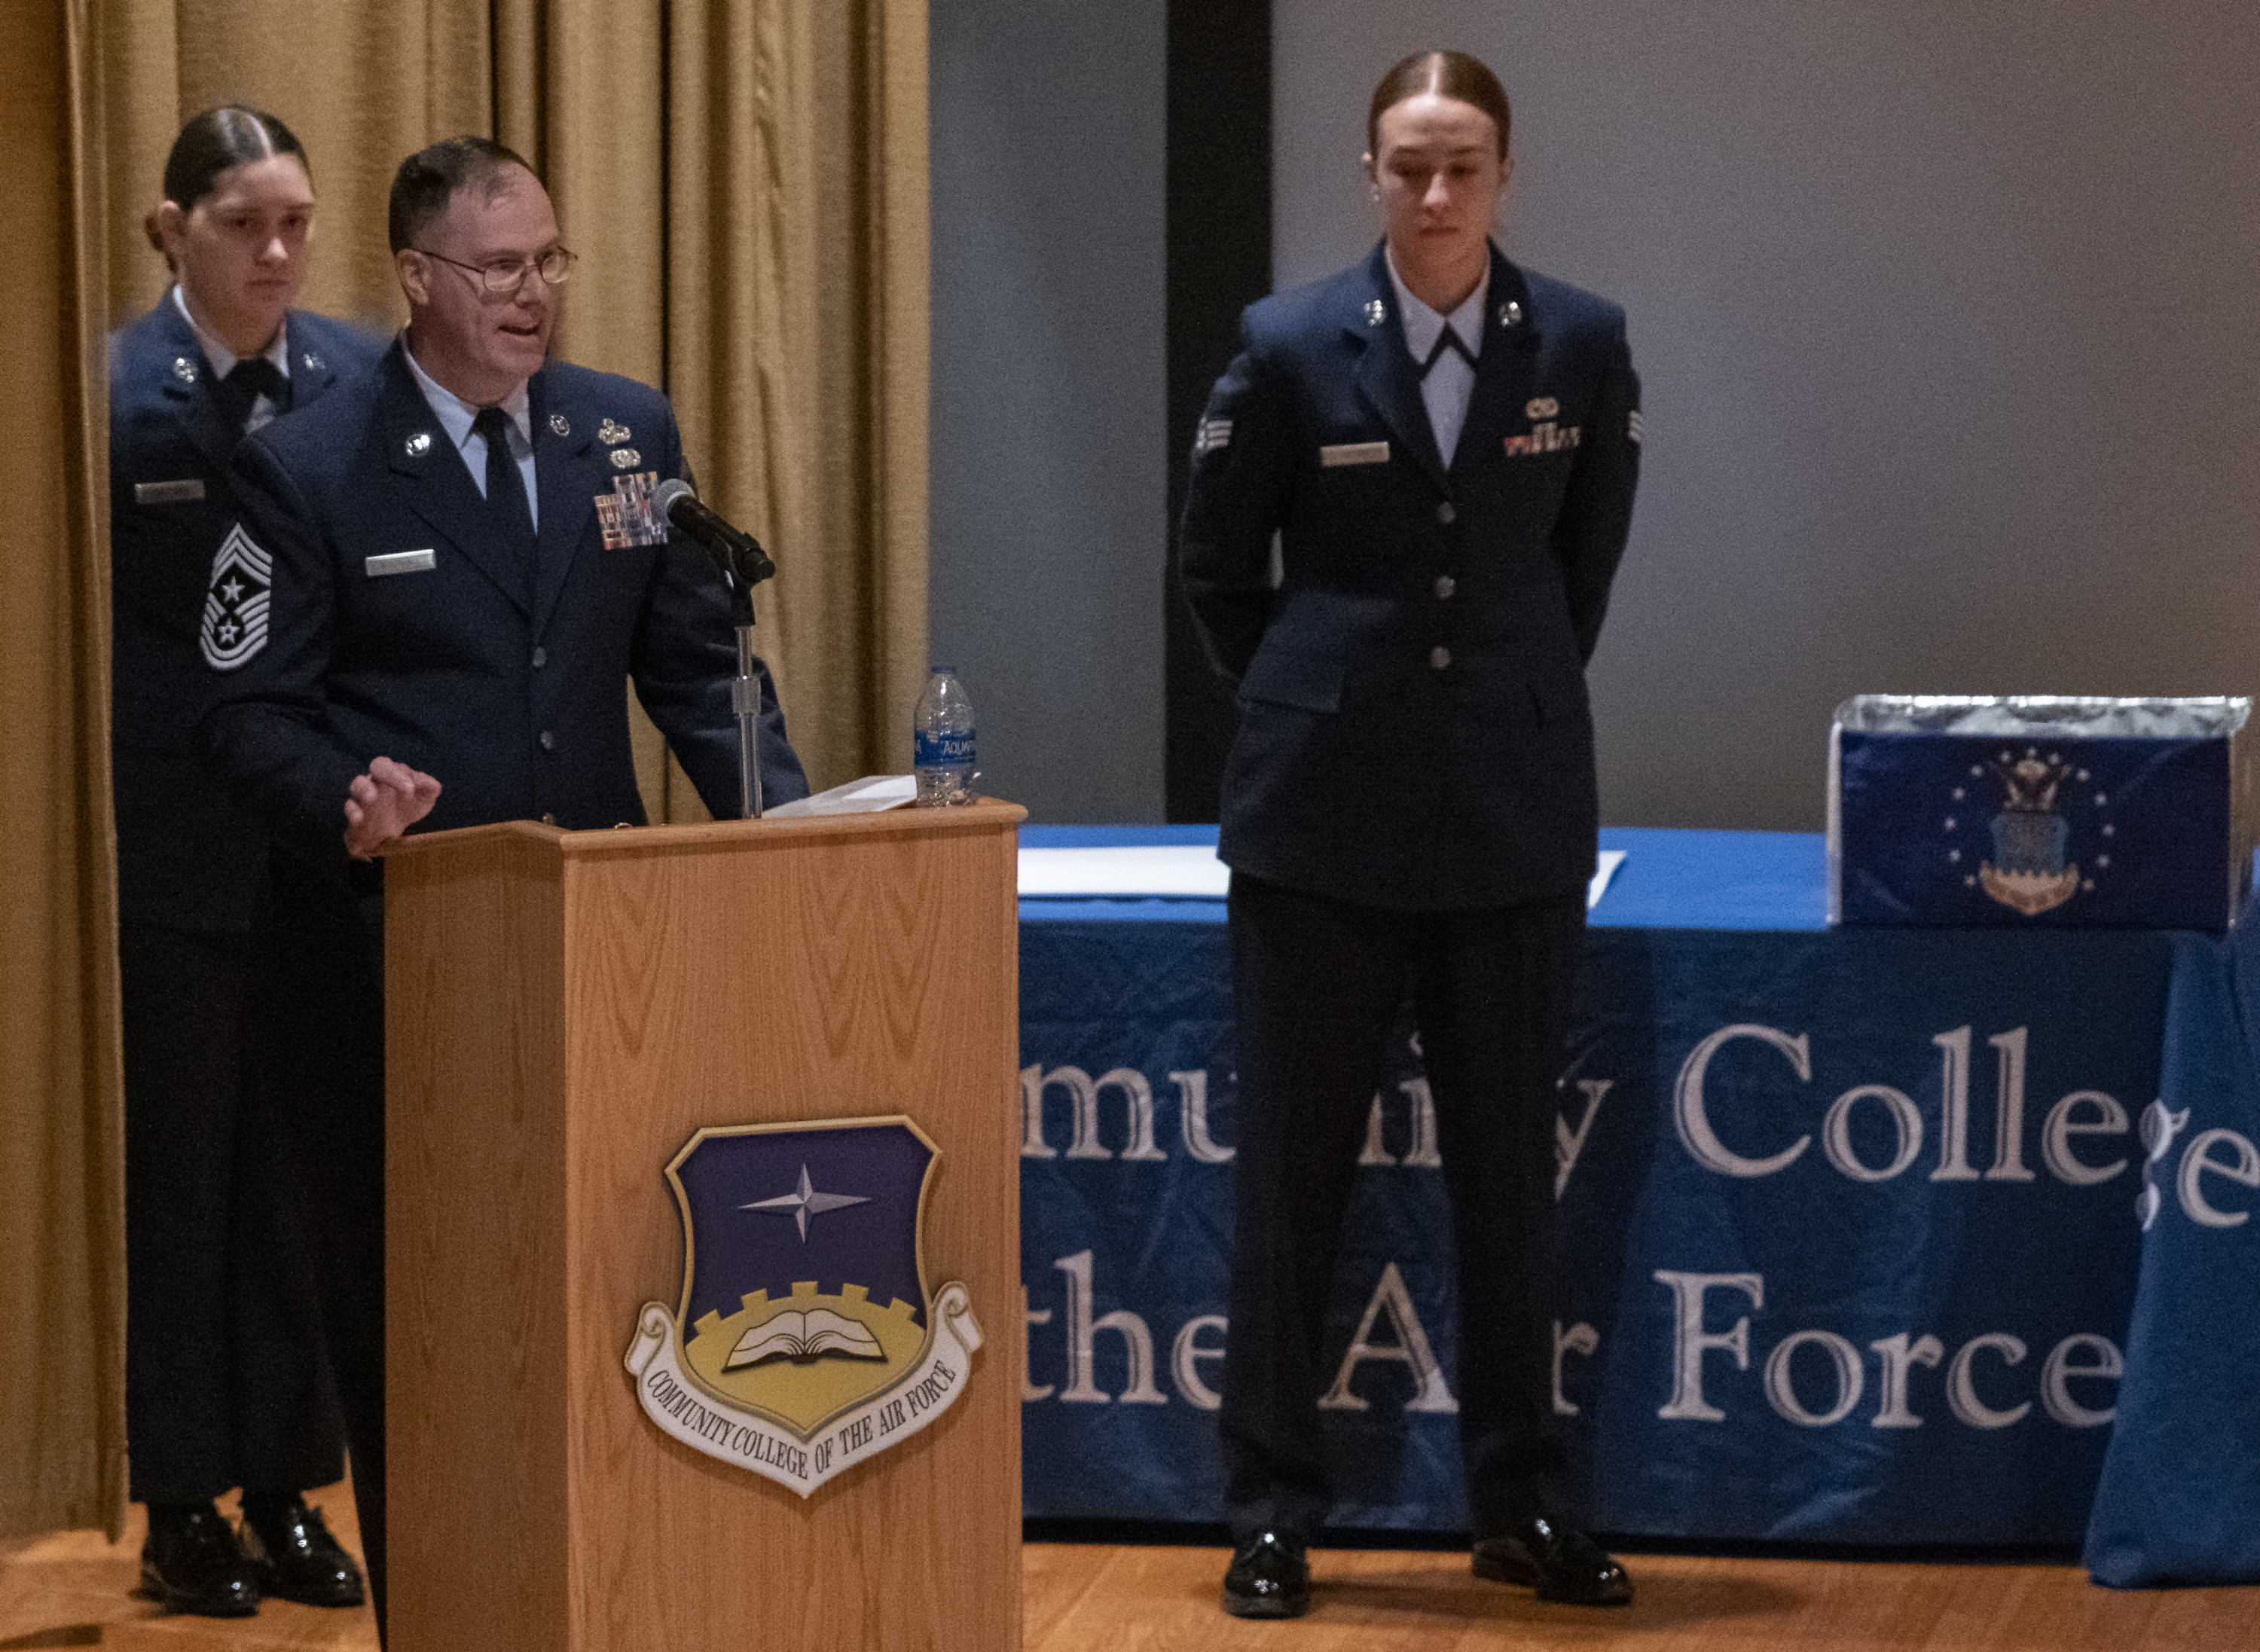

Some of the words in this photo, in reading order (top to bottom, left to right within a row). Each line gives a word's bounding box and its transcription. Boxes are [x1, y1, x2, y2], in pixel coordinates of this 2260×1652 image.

[1317, 1262, 1601, 1415] Ar
[1653, 1269, 2124, 1429] Force
[647, 1370, 737, 1446] COMMUNITY
[731, 1426, 808, 1480] COLLEGE
[814, 1437, 834, 1474] OF
[838, 1415, 874, 1456] THE
[879, 1399, 906, 1437] AIR
[905, 1359, 957, 1418] FORCE
